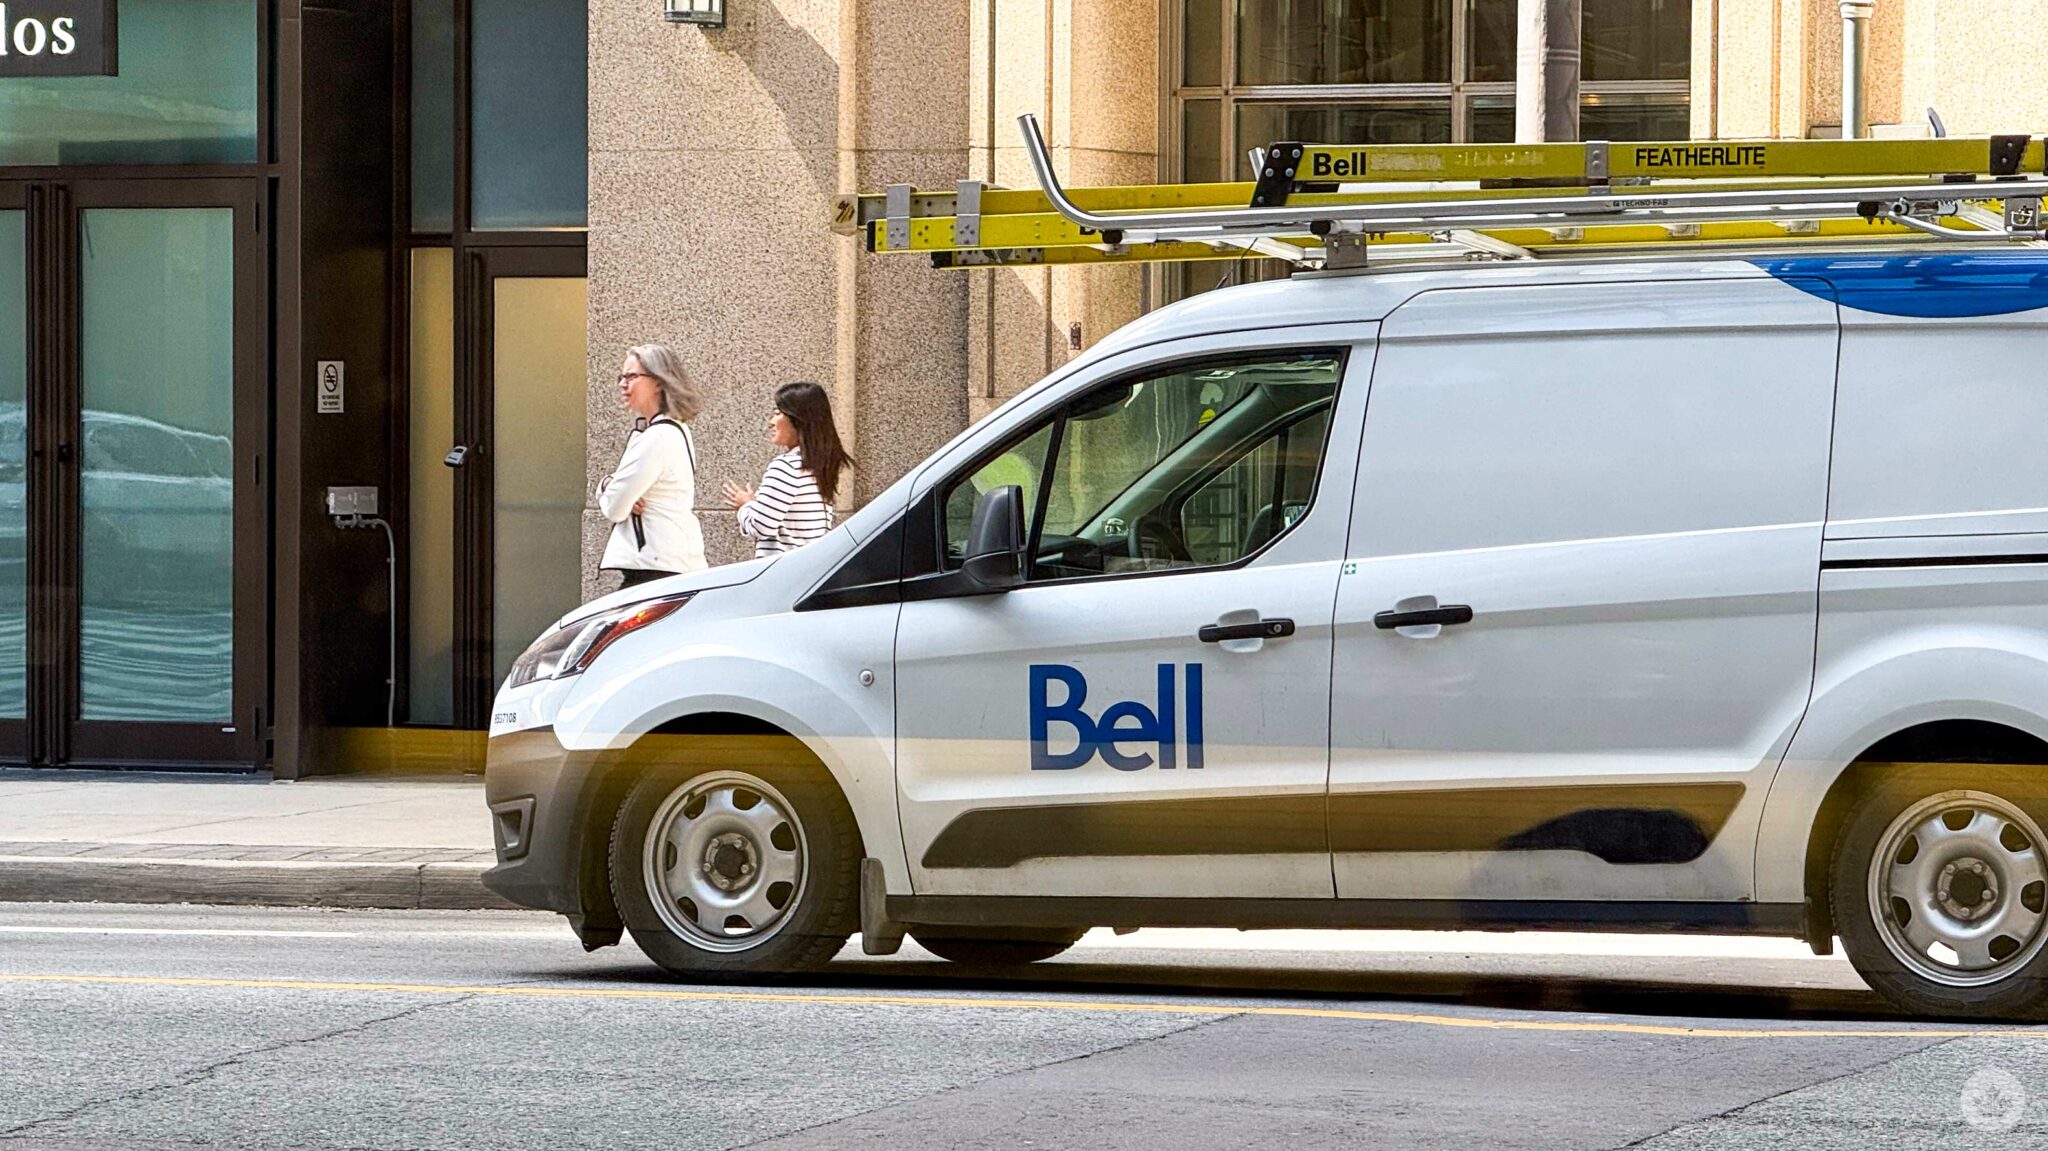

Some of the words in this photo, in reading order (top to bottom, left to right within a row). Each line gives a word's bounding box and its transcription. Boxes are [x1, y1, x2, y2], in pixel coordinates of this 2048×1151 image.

[1313, 152, 1366, 176] Bell
[1635, 146, 1765, 167] FEATHERLITE
[1029, 663, 1204, 771] Bell
